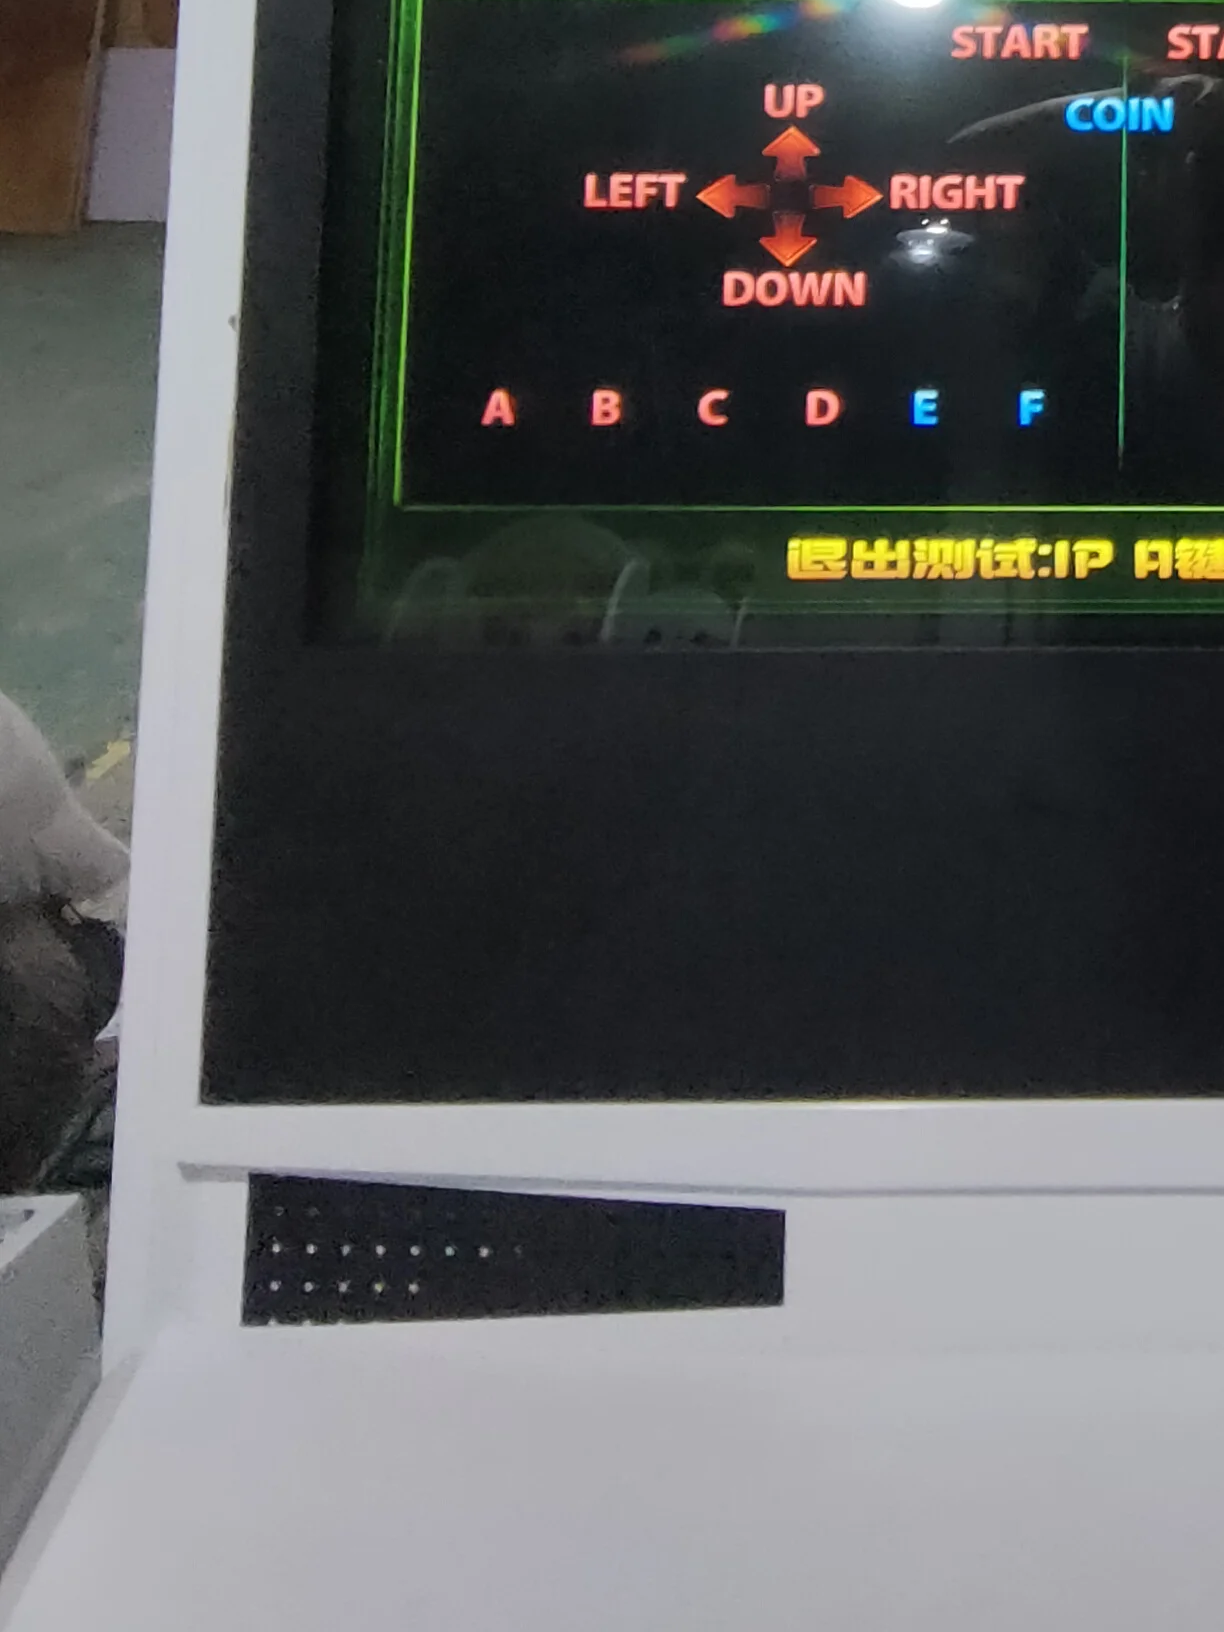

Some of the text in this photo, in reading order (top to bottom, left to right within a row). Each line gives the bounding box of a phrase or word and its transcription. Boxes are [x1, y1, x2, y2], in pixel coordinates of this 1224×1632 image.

[951, 23, 1090, 60] START
[763, 83, 826, 119] UP
[1064, 96, 1175, 134] COIN
[583, 172, 687, 210] LEFT
[889, 173, 1026, 212] RIGHT
[722, 270, 867, 308] DOWN
[481, 389, 1045, 427] A B C D E F
